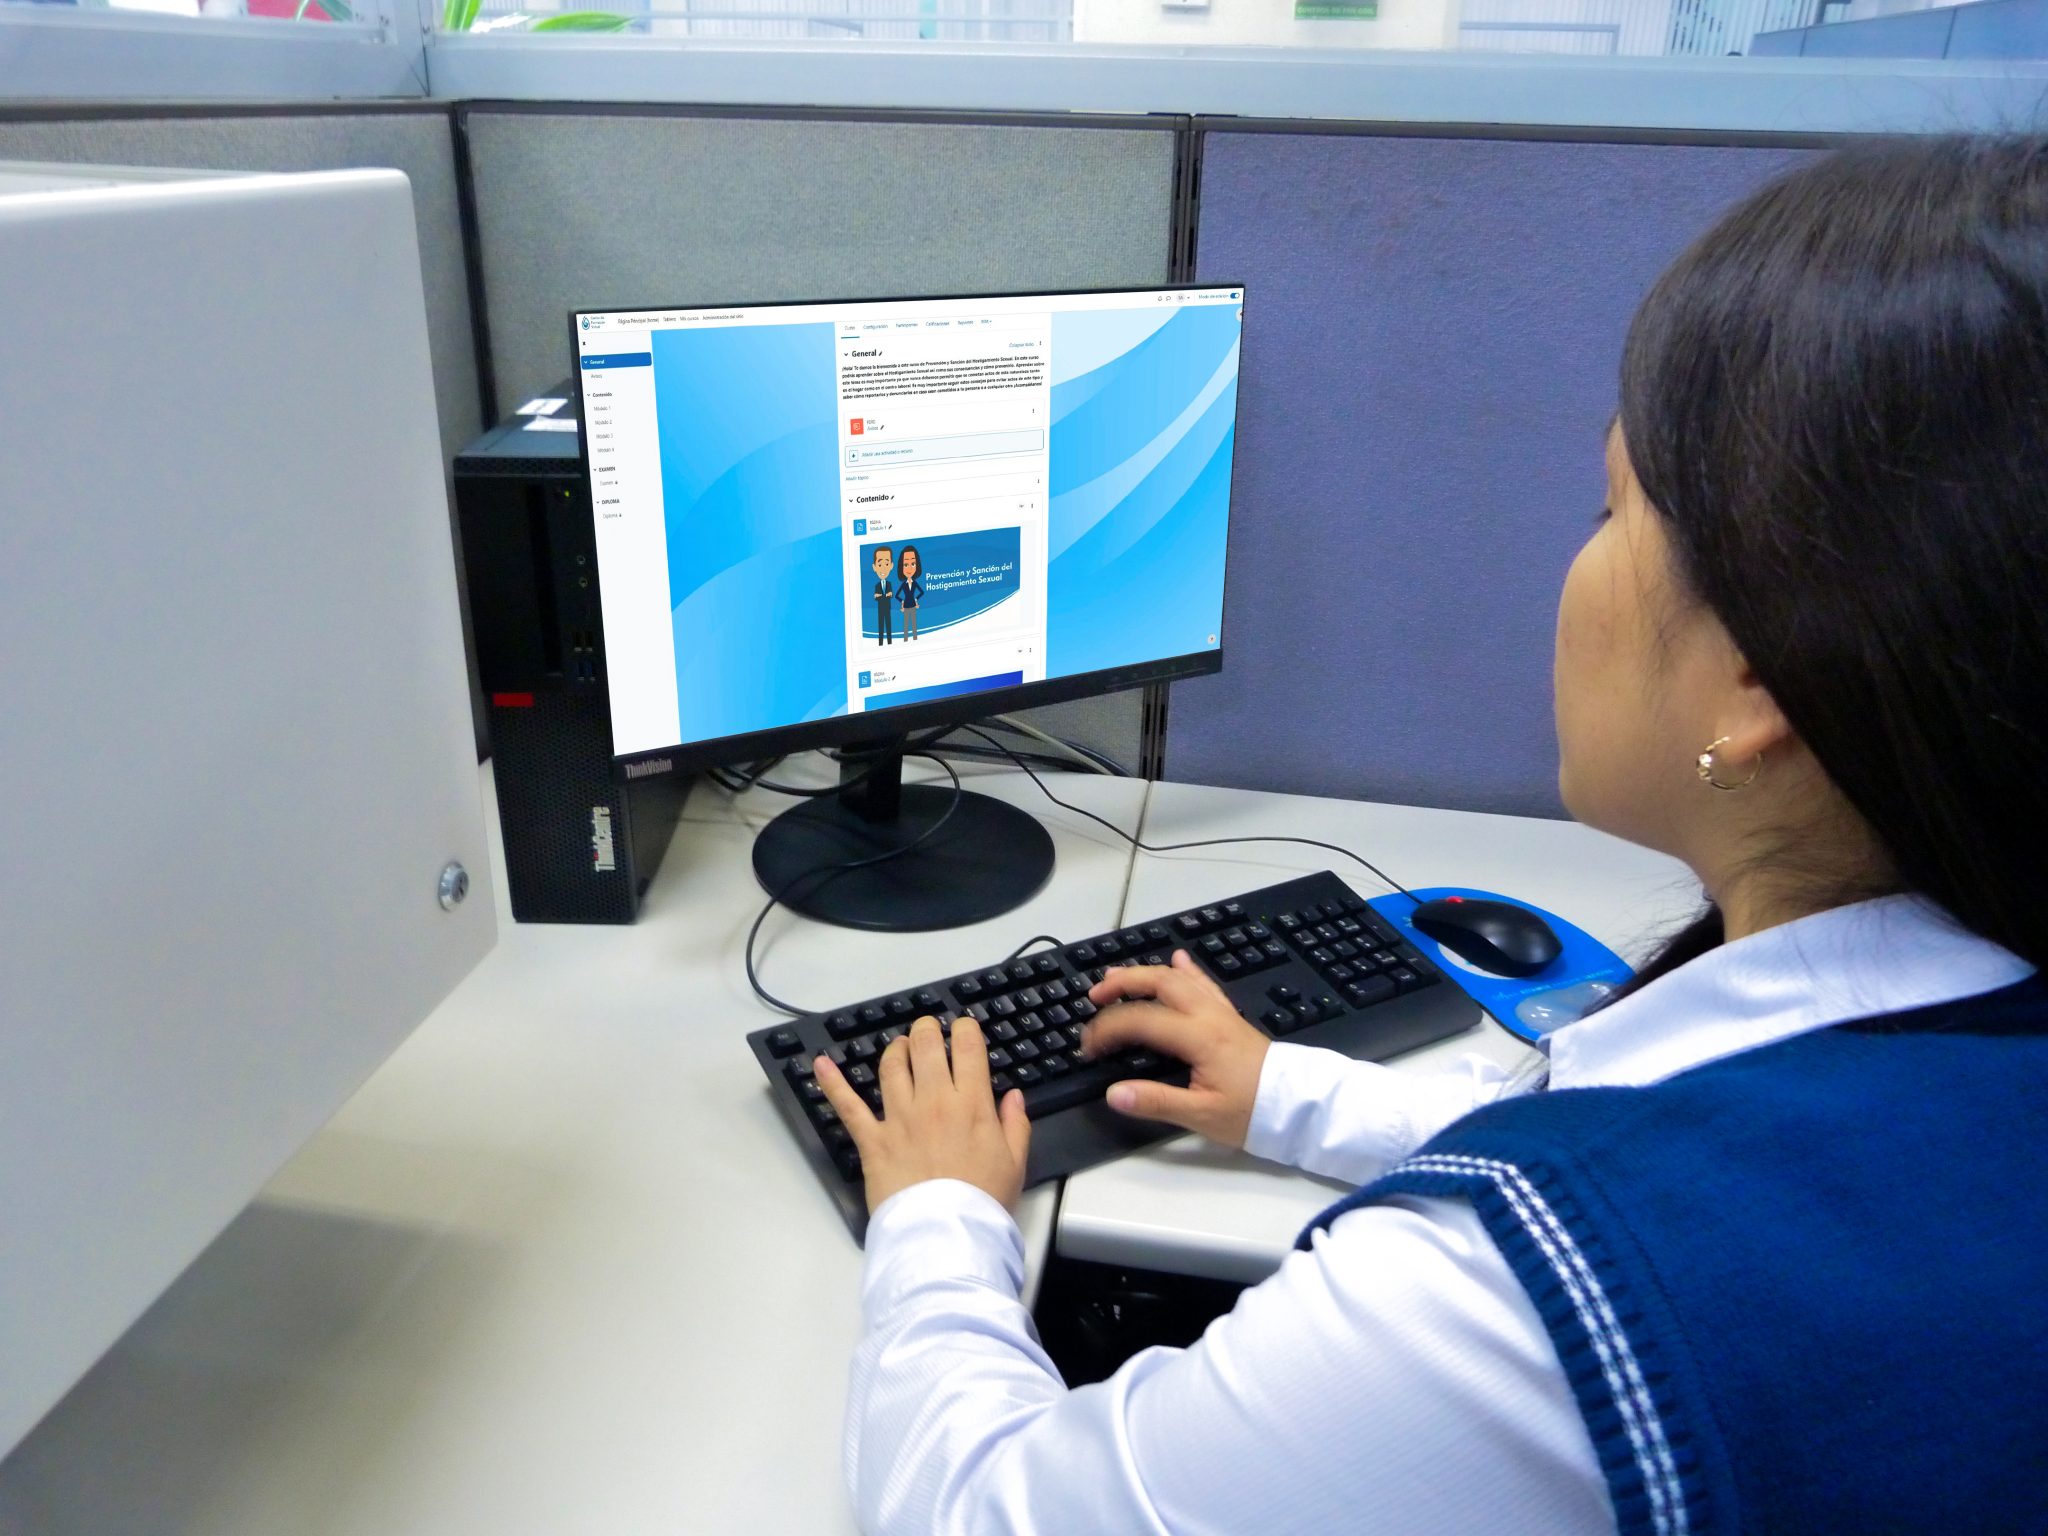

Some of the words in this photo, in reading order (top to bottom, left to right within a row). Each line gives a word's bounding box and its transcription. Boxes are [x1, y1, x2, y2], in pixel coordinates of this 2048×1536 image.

[851, 348, 877, 358] General
[856, 494, 890, 503] Contenido
[925, 569, 965, 581] Prevención
[966, 569, 971, 578] y
[972, 564, 1000, 576] Sanción
[1001, 562, 1013, 571] del
[926, 576, 977, 591] Hostigamiento
[978, 573, 1003, 584] Sexual
[624, 758, 673, 779] ThinkVision
